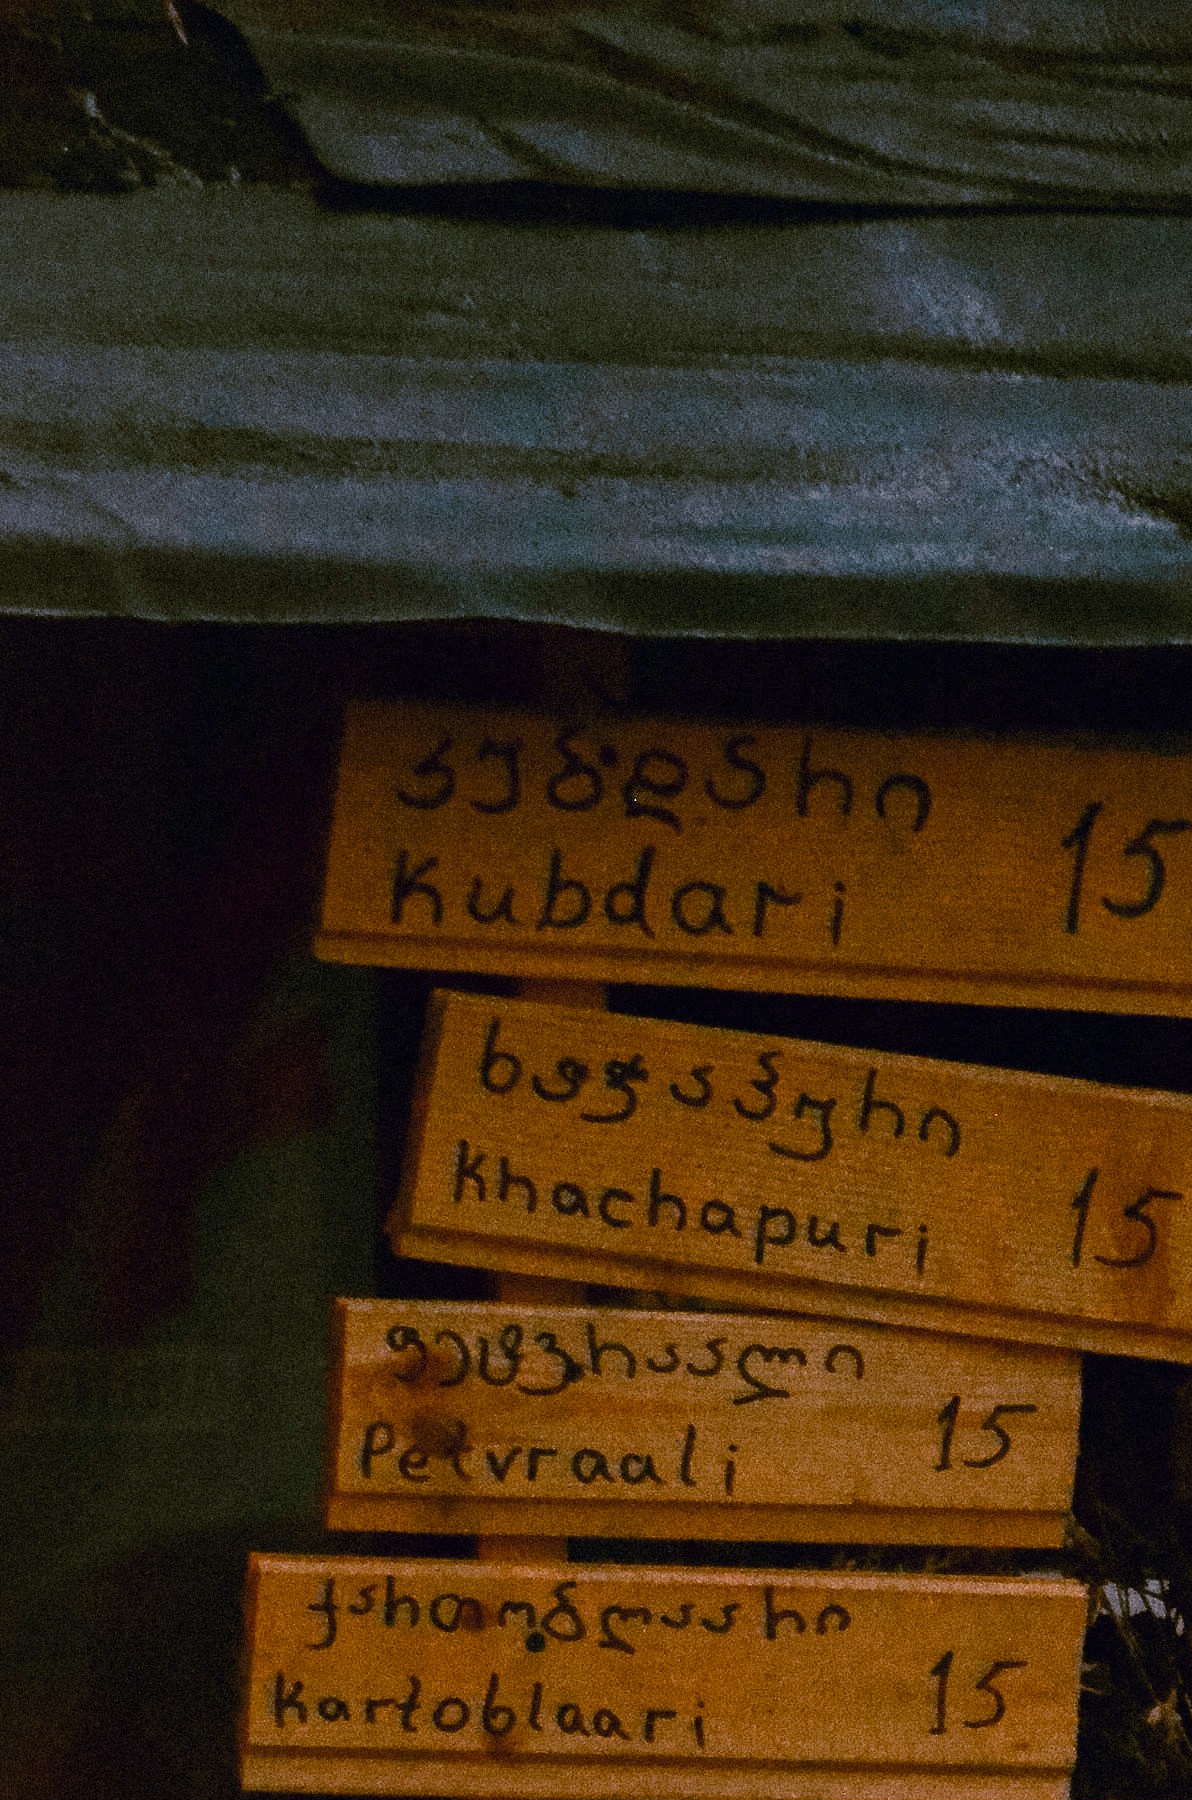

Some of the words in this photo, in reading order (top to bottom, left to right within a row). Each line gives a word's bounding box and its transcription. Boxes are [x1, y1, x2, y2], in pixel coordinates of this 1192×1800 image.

[390, 846, 846, 945] Kubdari
[1071, 1168, 1182, 1267] 15
[359, 1422, 737, 1495] Petvraali
[935, 1396, 1037, 1472] 15
[930, 1651, 1028, 1736] 15
